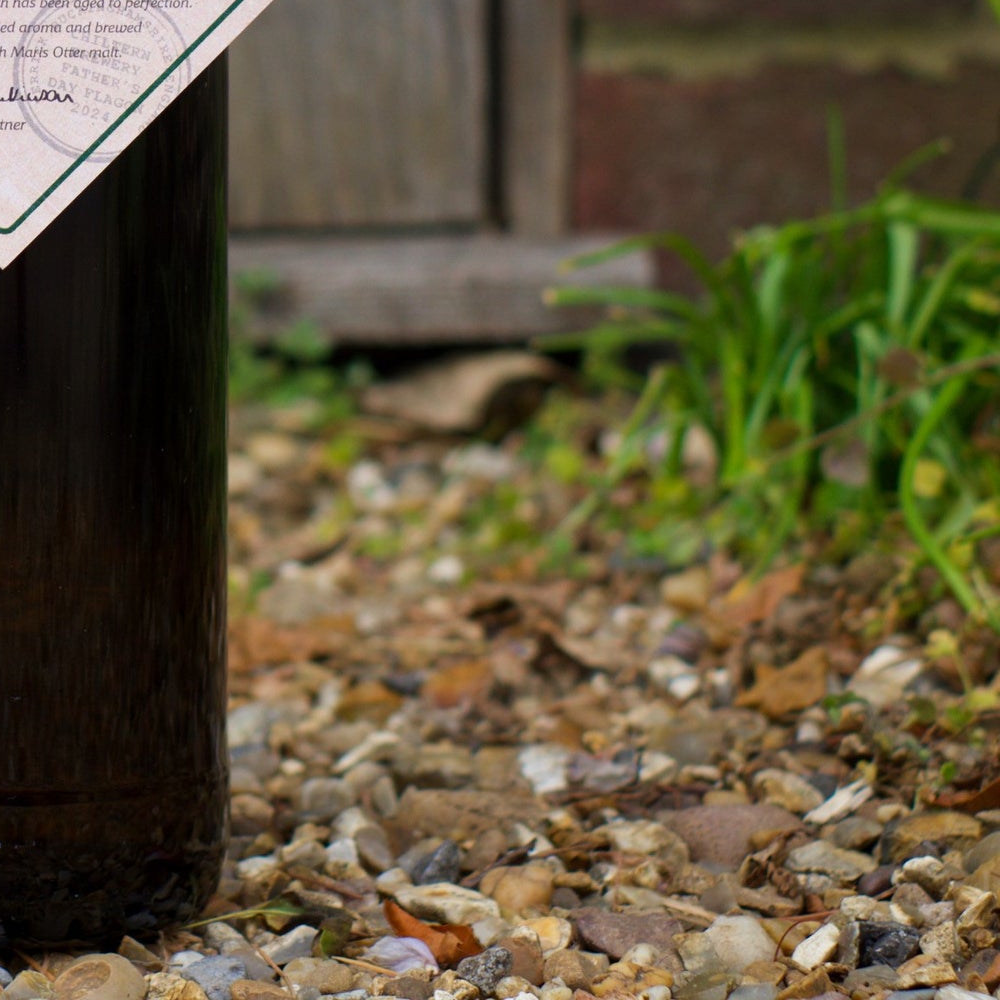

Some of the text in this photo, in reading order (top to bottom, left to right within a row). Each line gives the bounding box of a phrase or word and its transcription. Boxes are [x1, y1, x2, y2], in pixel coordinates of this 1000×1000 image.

[108, 0, 122, 8] to
[18, 24, 62, 33] aroma
[65, 21, 91, 33] and
[95, 21, 143, 33] brewed
[10, 46, 48, 58] Maris
[52, 46, 86, 58] Otter
[88, 46, 122, 58] malt.
